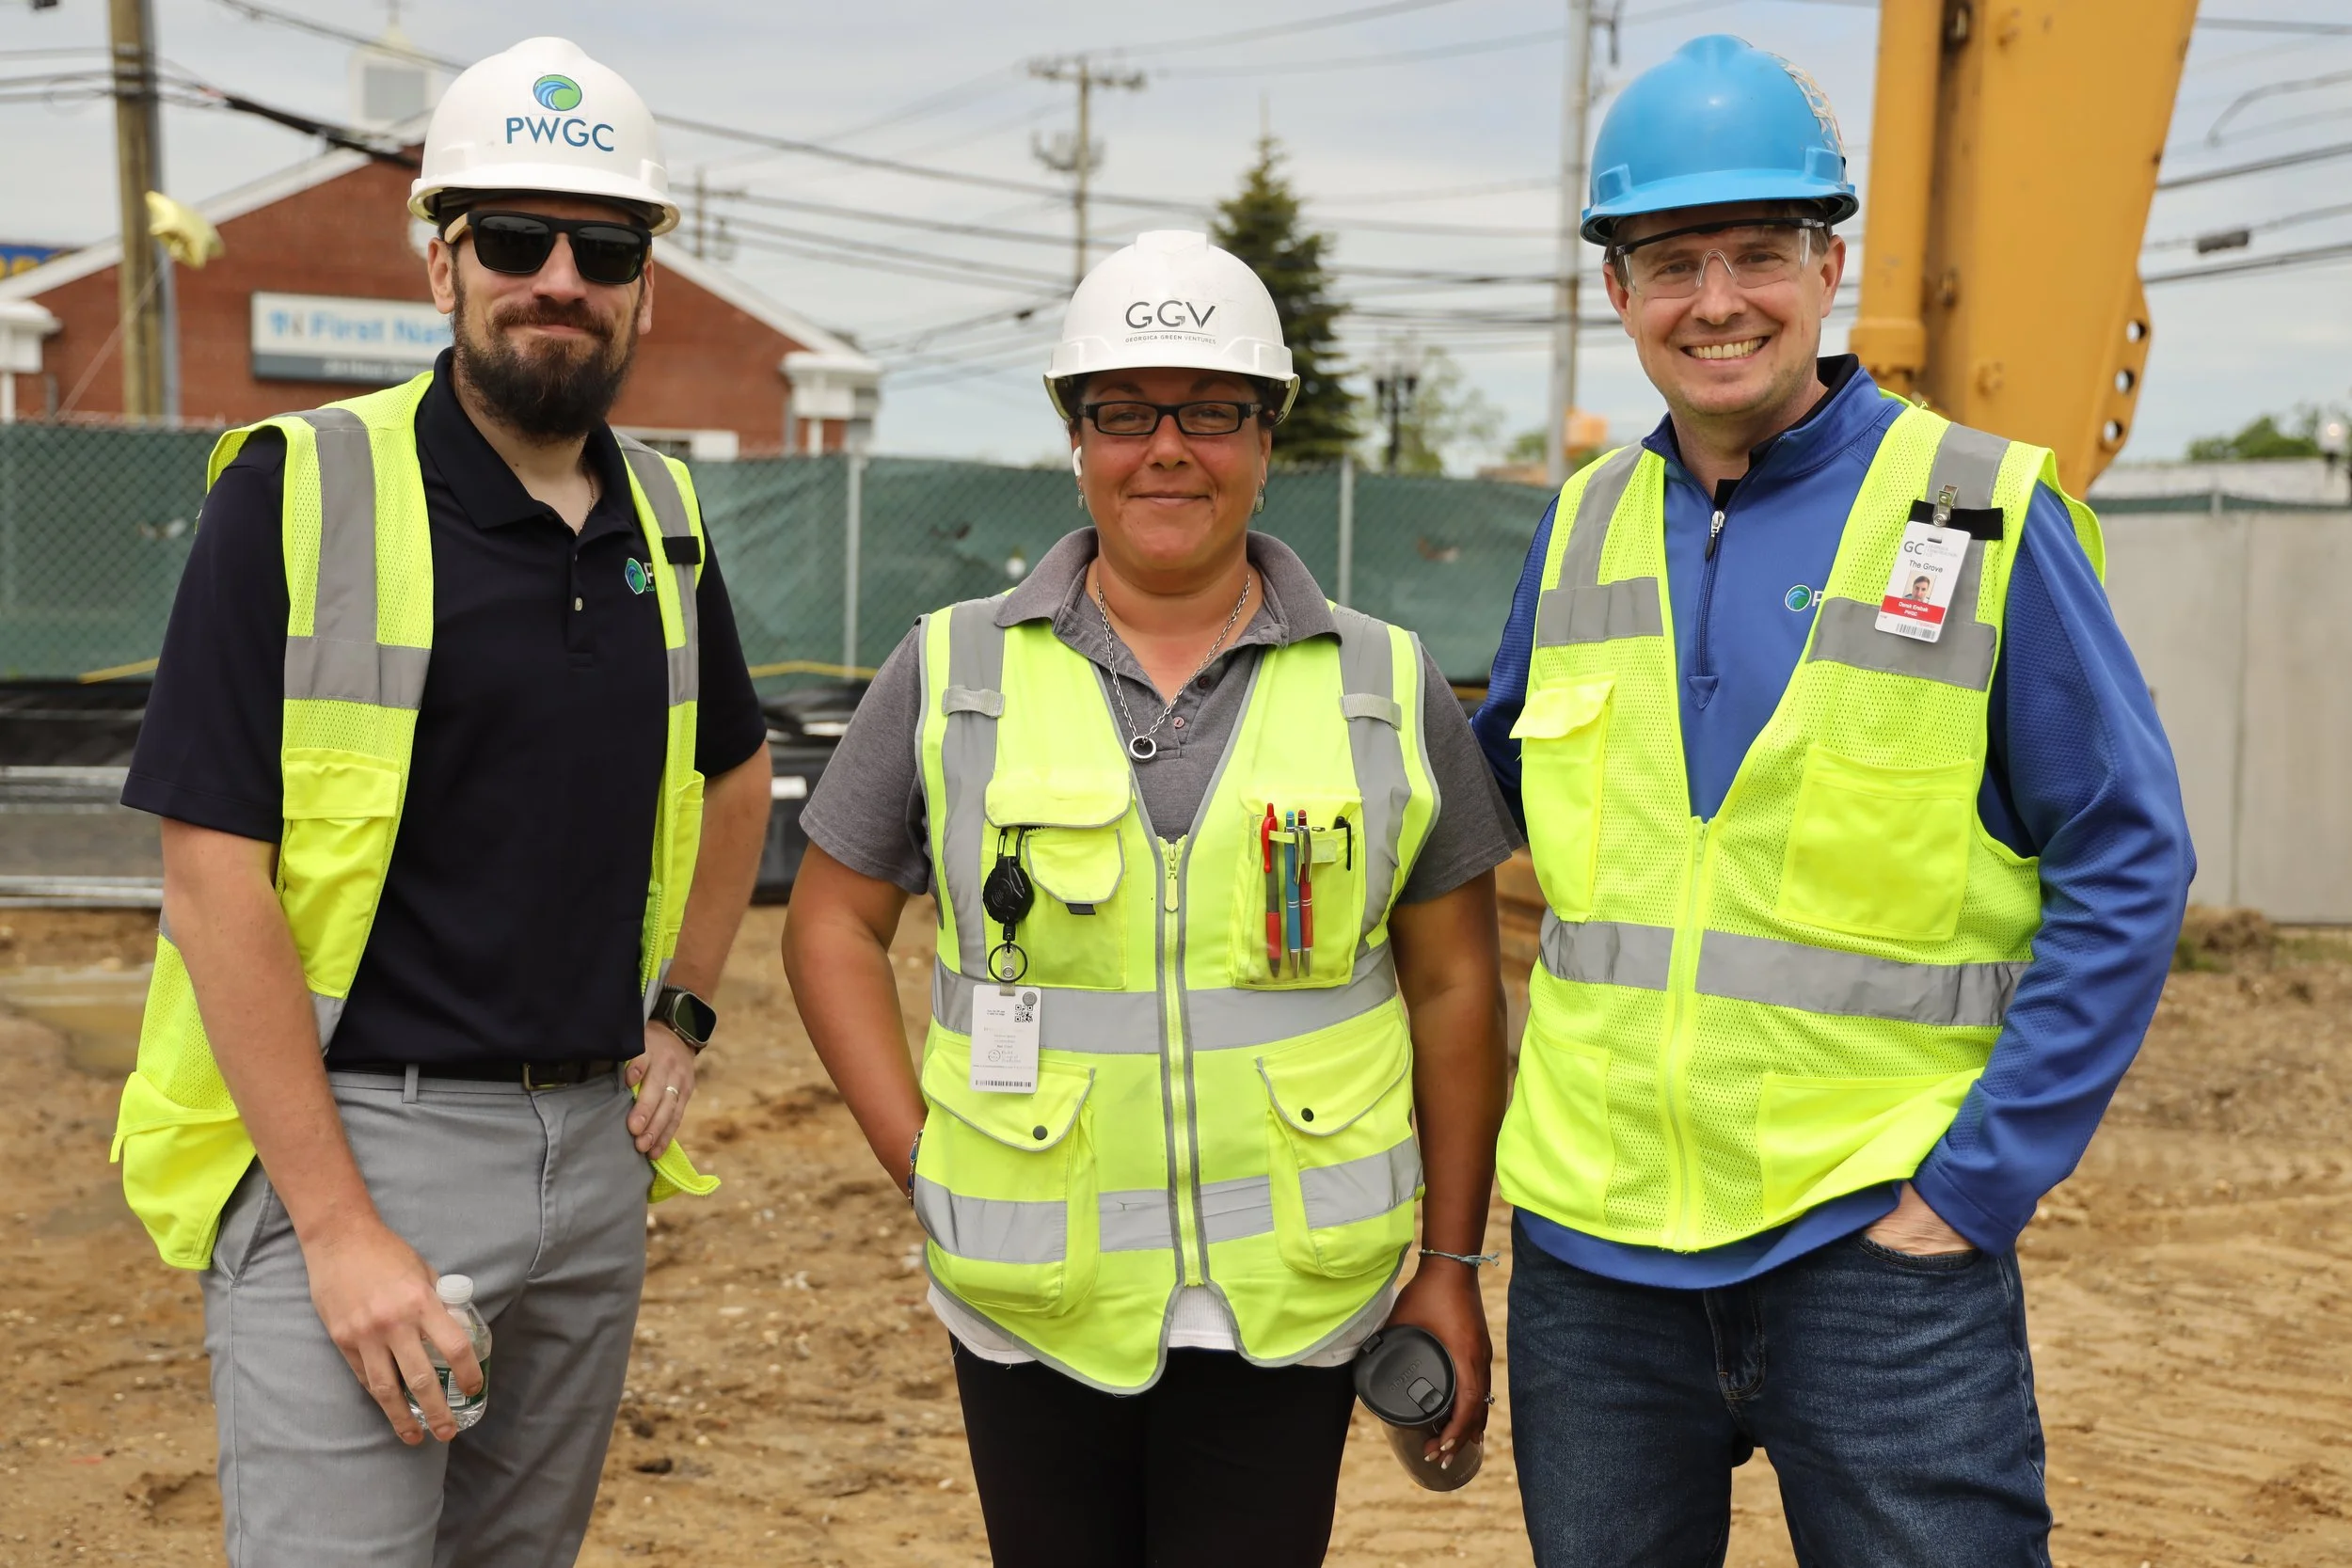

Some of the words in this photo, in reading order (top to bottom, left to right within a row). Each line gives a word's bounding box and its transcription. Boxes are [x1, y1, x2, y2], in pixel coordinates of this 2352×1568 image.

[506, 117, 614, 152] PWGC
[1125, 300, 1216, 329] GGV
[309, 310, 383, 341] First
[1125, 335, 1158, 343] GEORGICA
[1184, 336, 1216, 345] VENTURES
[1903, 541, 1925, 555] GC
[1910, 560, 1922, 569] The
[1922, 562, 1944, 573] Grove
